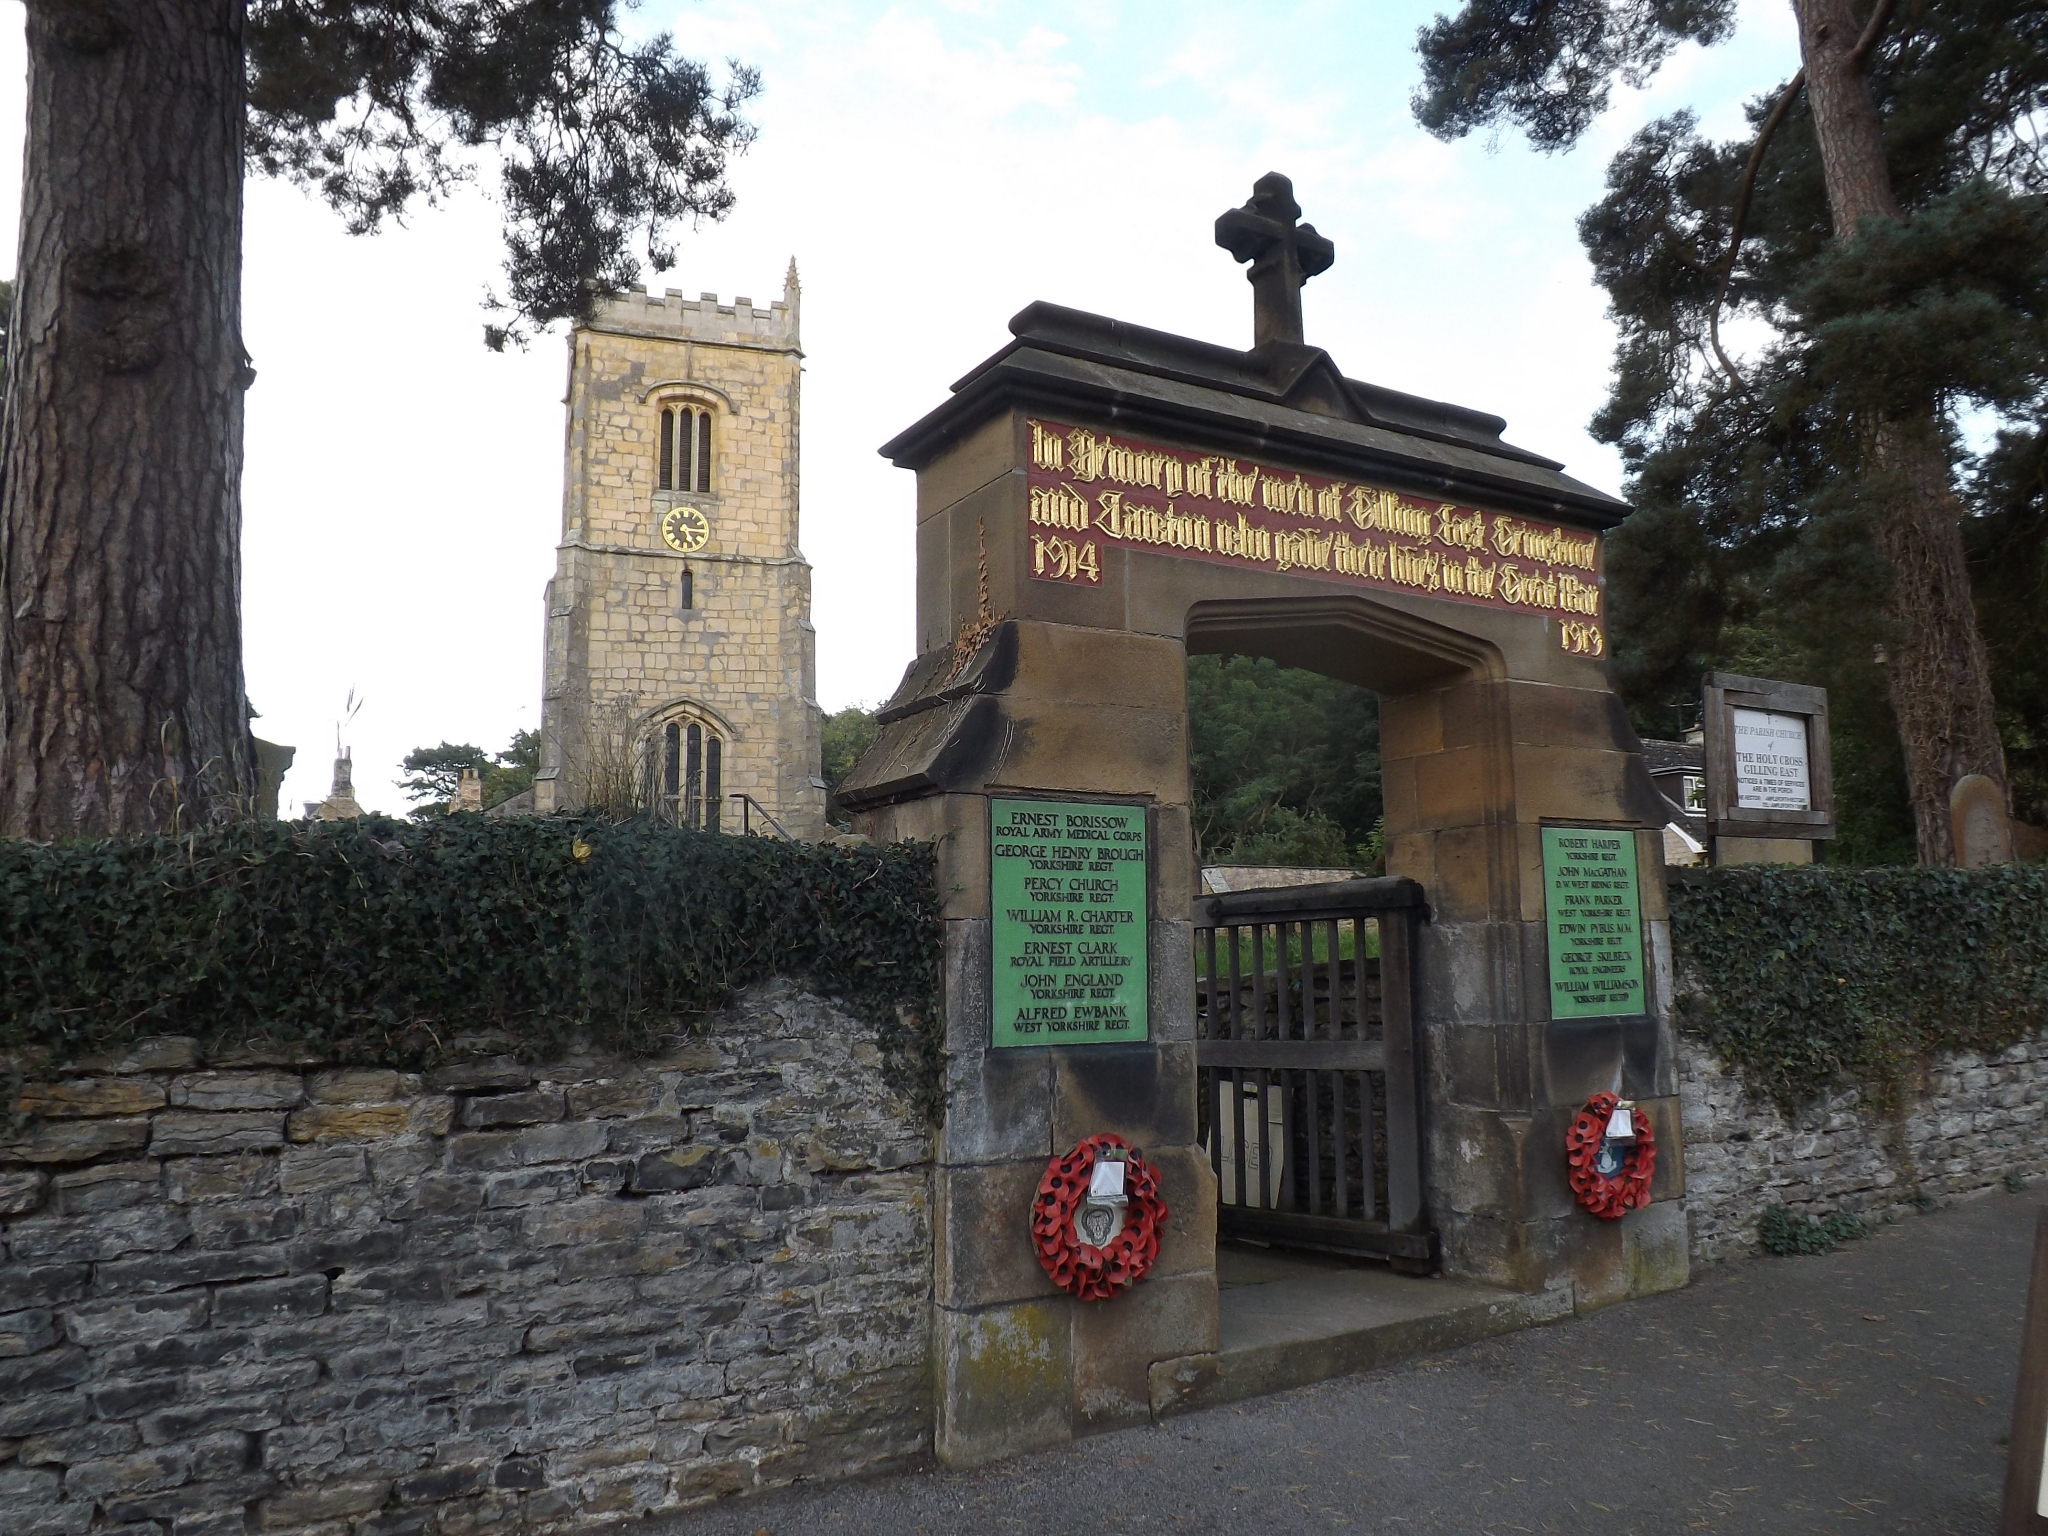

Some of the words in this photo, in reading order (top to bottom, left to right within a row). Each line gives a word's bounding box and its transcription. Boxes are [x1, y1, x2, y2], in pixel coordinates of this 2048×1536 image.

[1027, 419, 1065, 473] In
[1066, 427, 1184, 498] Memory
[1186, 456, 1218, 500] of
[1216, 458, 1259, 507] the
[1259, 474, 1316, 518] men
[1316, 481, 1347, 523] of
[1345, 486, 1432, 546] Gilling
[1029, 482, 1089, 532] and
[1214, 512, 1271, 562] who
[1274, 528, 1334, 571] gave
[1333, 531, 1388, 580] their
[1388, 540, 1441, 593] lives
[1441, 552, 1466, 596] in
[1465, 555, 1497, 599] the
[1497, 563, 1558, 609] Great
[1557, 573, 1599, 616] War
[1030, 533, 1100, 582] 1914
[1559, 618, 1604, 656] 1919
[1735, 726, 1749, 735] THE
[1750, 727, 1775, 737] PARISH
[1775, 729, 1802, 740] CHURCH
[1736, 752, 1754, 763] THE
[1756, 754, 1778, 764] HOLY
[1779, 756, 1803, 766] CROSS
[1744, 765, 1778, 776] GILLING
[1780, 767, 1798, 777] EAST
[1011, 812, 1059, 827] ERNEST
[1066, 815, 1129, 829] BORISSOW
[996, 826, 1030, 838] ROYAL
[1032, 828, 1063, 839] ARMY
[1066, 829, 1110, 841] MEDICAL
[1113, 831, 1142, 842] CORPS
[1558, 838, 1588, 848] ROBERT
[1592, 839, 1621, 850] HARPER
[995, 844, 1047, 858] GEORGE
[1052, 846, 1092, 860] HENRY
[1097, 848, 1144, 861] BROUGH
[1565, 852, 1599, 860] YORKSHIRE
[1029, 860, 1083, 871] YORKSHIRE
[1088, 861, 1114, 872] REGT.
[1557, 867, 1580, 877] JOHN
[1024, 877, 1064, 890] PERCY
[1069, 878, 1119, 892] CHURCH
[1591, 881, 1611, 889] RIDING
[1030, 892, 1084, 902] YORKSHIRE
[1089, 893, 1114, 903] REGT.
[1564, 895, 1591, 905] FRANK
[1594, 895, 1623, 905] PARKER
[1006, 909, 1061, 923] WILLIAM
[1067, 910, 1079, 923] R.
[1080, 910, 1134, 923] CHARTER
[1557, 909, 1577, 917] WEST
[1580, 909, 1613, 917] YORKSHIRE
[1029, 924, 1084, 934] YORKSHIRE
[1089, 924, 1114, 934] REGT.
[1559, 924, 1586, 934] EDWIN
[1024, 942, 1073, 954] ERNEST
[1077, 942, 1118, 954] CLARK
[1010, 956, 1044, 967] ROYAL
[1048, 956, 1076, 966] FIELD
[1080, 956, 1133, 966] ARTILLERY
[1561, 952, 1593, 963] GEORGE
[1597, 951, 1632, 962] SKILBECK
[1569, 966, 1589, 975] ROYAL
[1592, 965, 1626, 974] ENGINEERS
[1020, 974, 1057, 988] JOHN
[1065, 974, 1123, 987] ENGLAND
[1555, 981, 1589, 992] WILLIAM
[1593, 979, 1639, 990] WILLIAMSON
[1030, 988, 1084, 1000] YORKSHIRE
[1573, 994, 1606, 1003] YORKSHIRE
[1017, 1007, 1067, 1021] ALFRED
[1074, 1005, 1127, 1019] EWBANK
[1013, 1022, 1042, 1033] WEST
[1046, 1020, 1100, 1032] YORKSHIRE
[1104, 1020, 1130, 1030] REGT.
